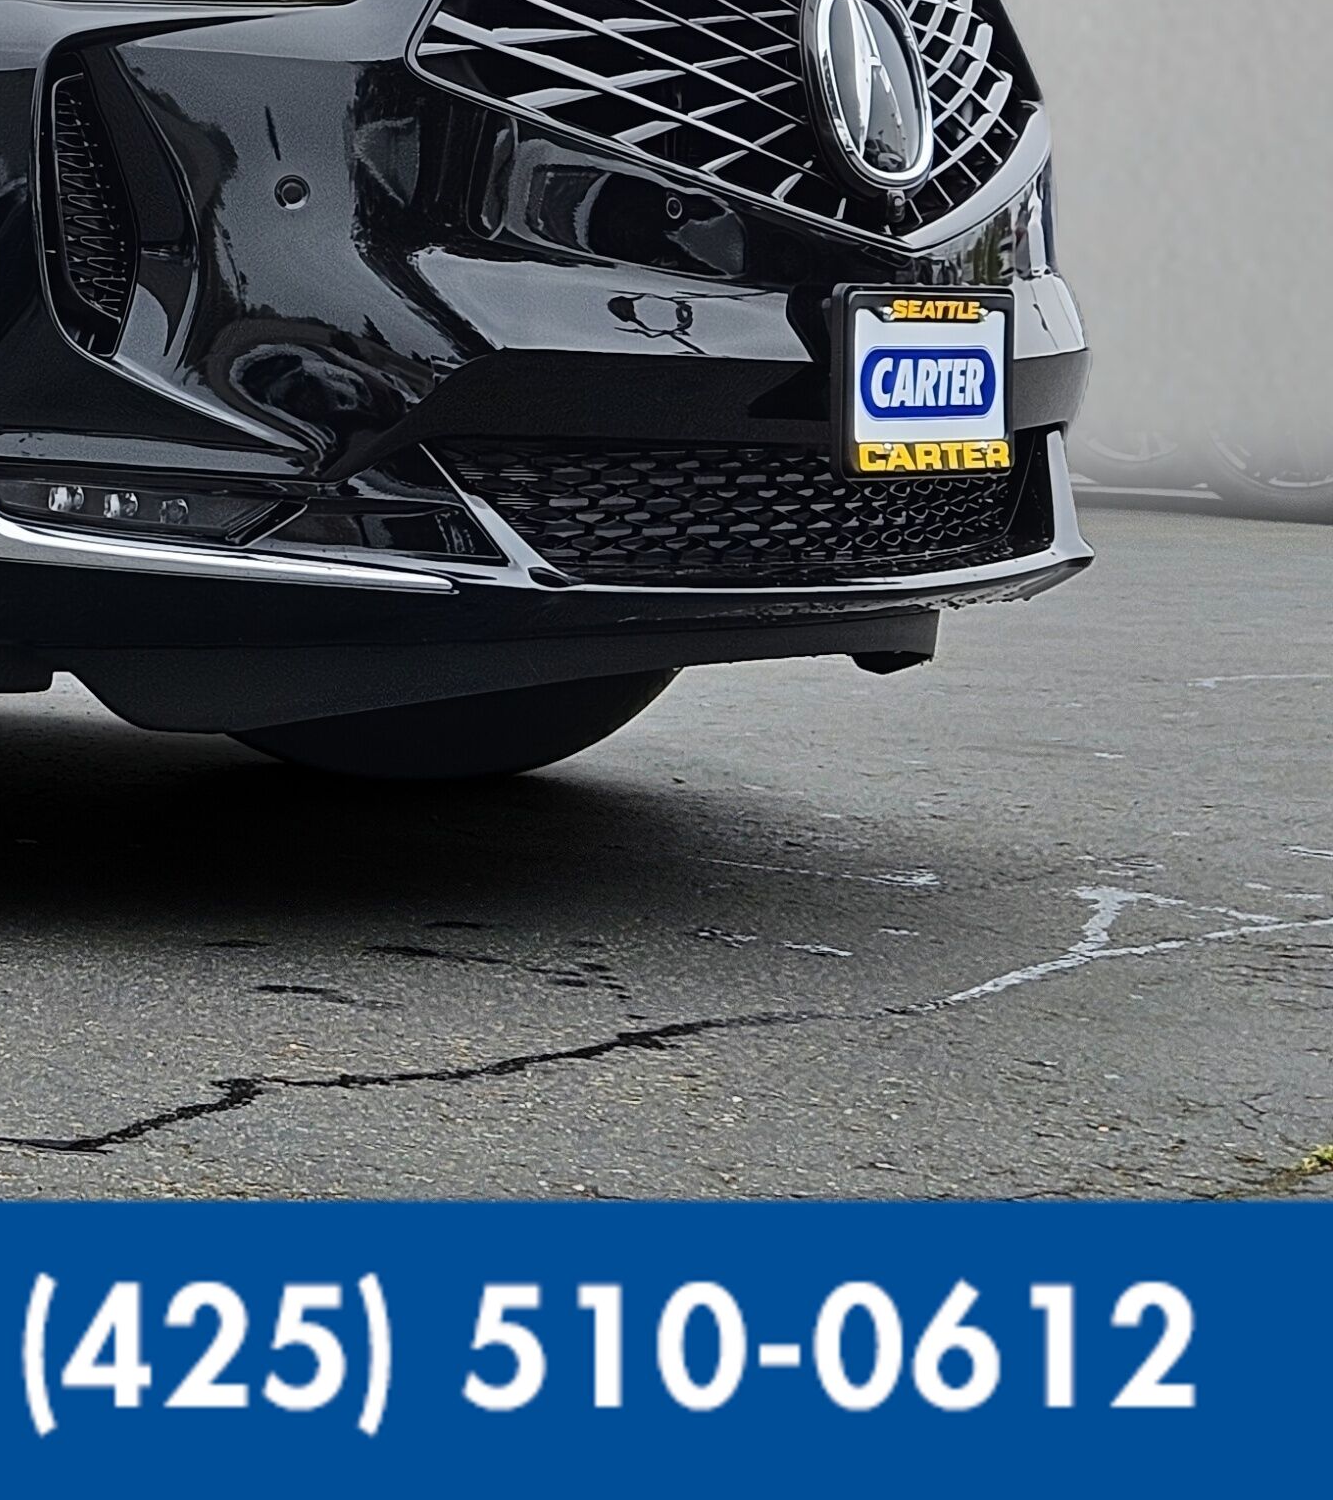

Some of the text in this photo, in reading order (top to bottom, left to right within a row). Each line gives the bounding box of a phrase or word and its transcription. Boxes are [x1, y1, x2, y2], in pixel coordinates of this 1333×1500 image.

[892, 299, 981, 321] SEATTLE
[870, 357, 986, 408] CARTER
[858, 441, 1012, 473] CARTER
